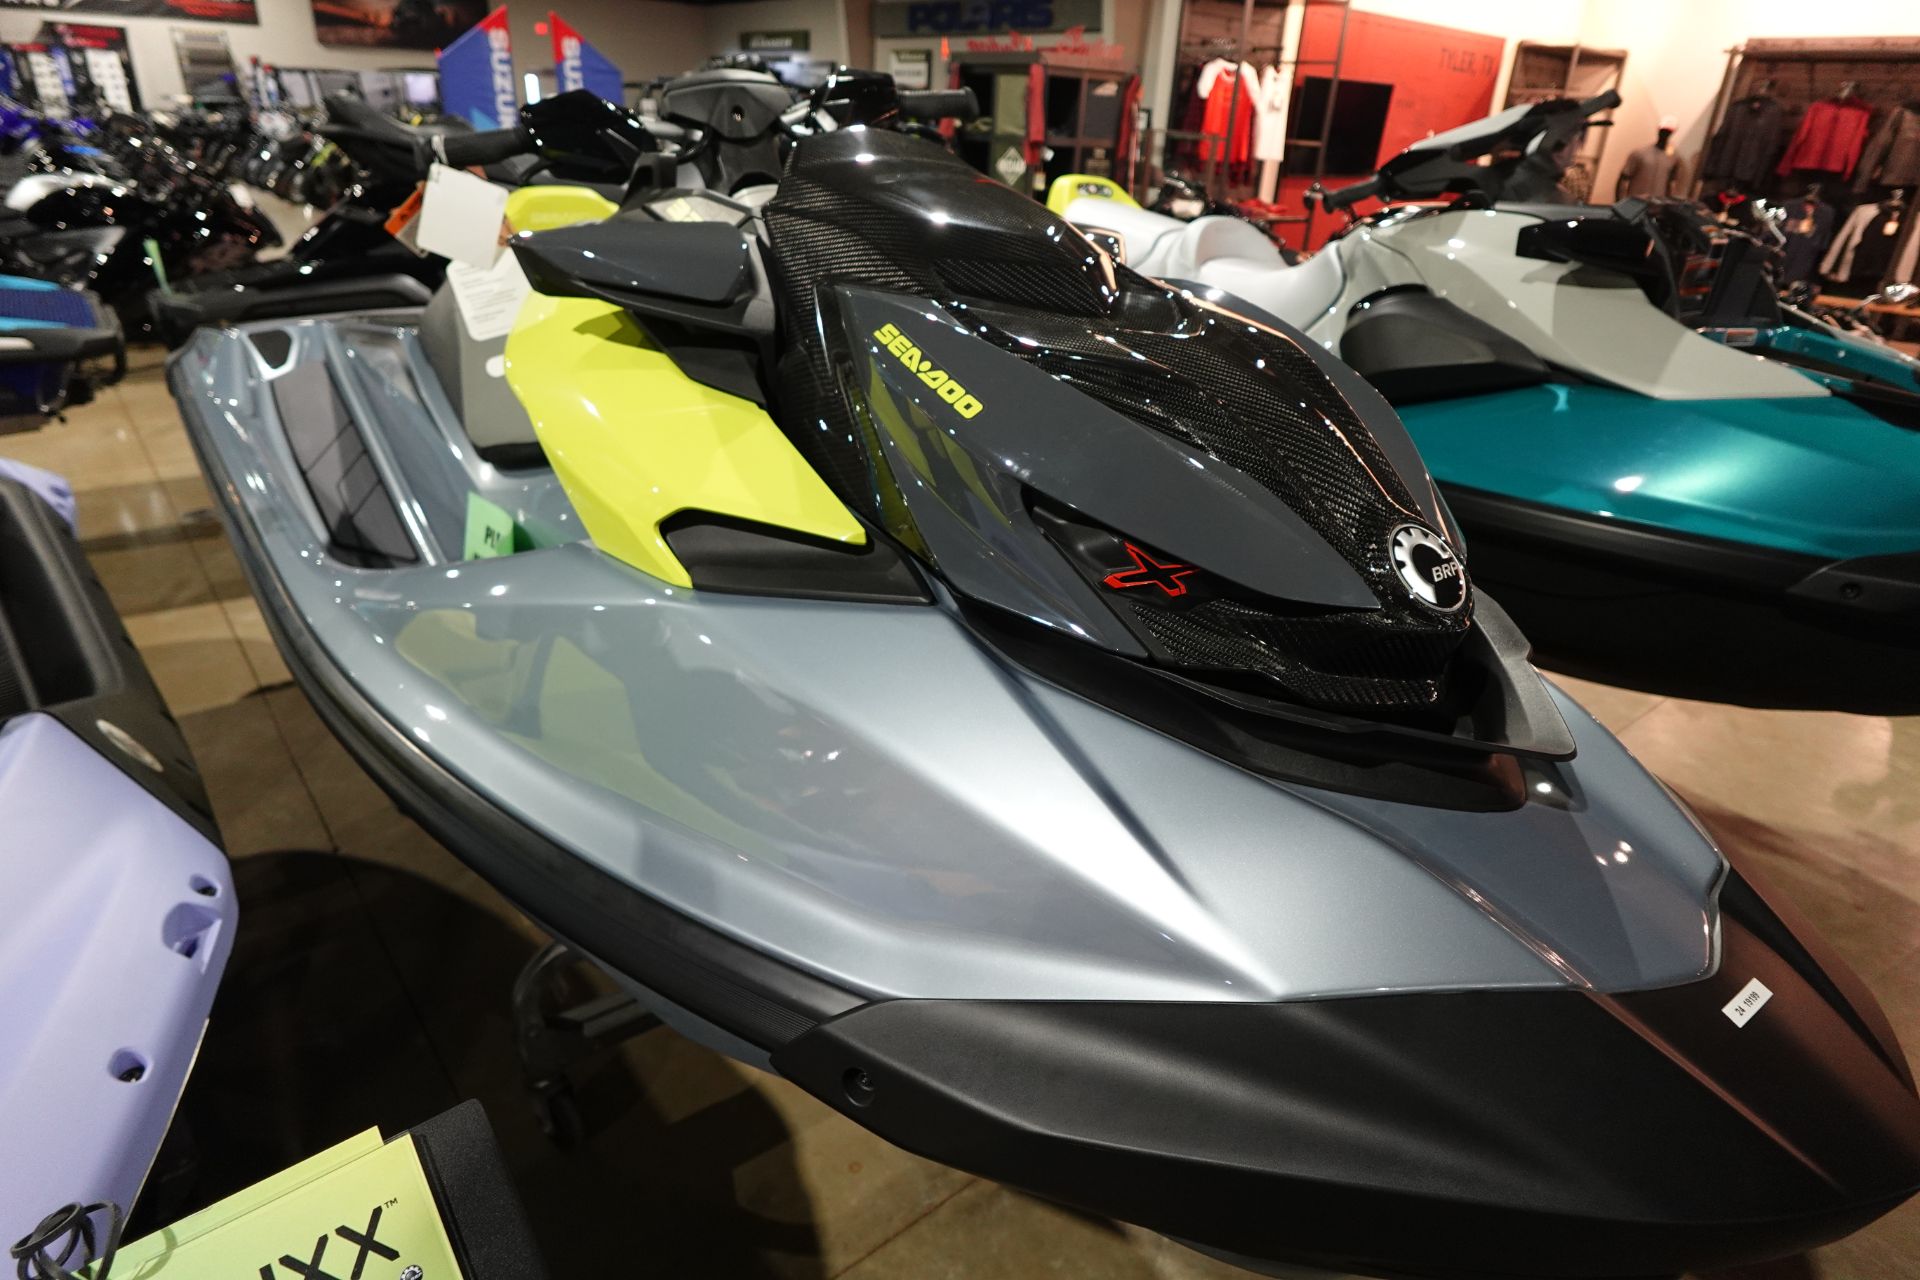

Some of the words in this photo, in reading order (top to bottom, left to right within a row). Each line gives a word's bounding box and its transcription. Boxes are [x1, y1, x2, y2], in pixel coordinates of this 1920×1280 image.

[908, 2, 1054, 32] POLARIS
[488, 27, 518, 130] SUZUK
[560, 36, 584, 93] SUZ
[1432, 561, 1459, 583] BRP
[1734, 1005, 1747, 1016] 24
